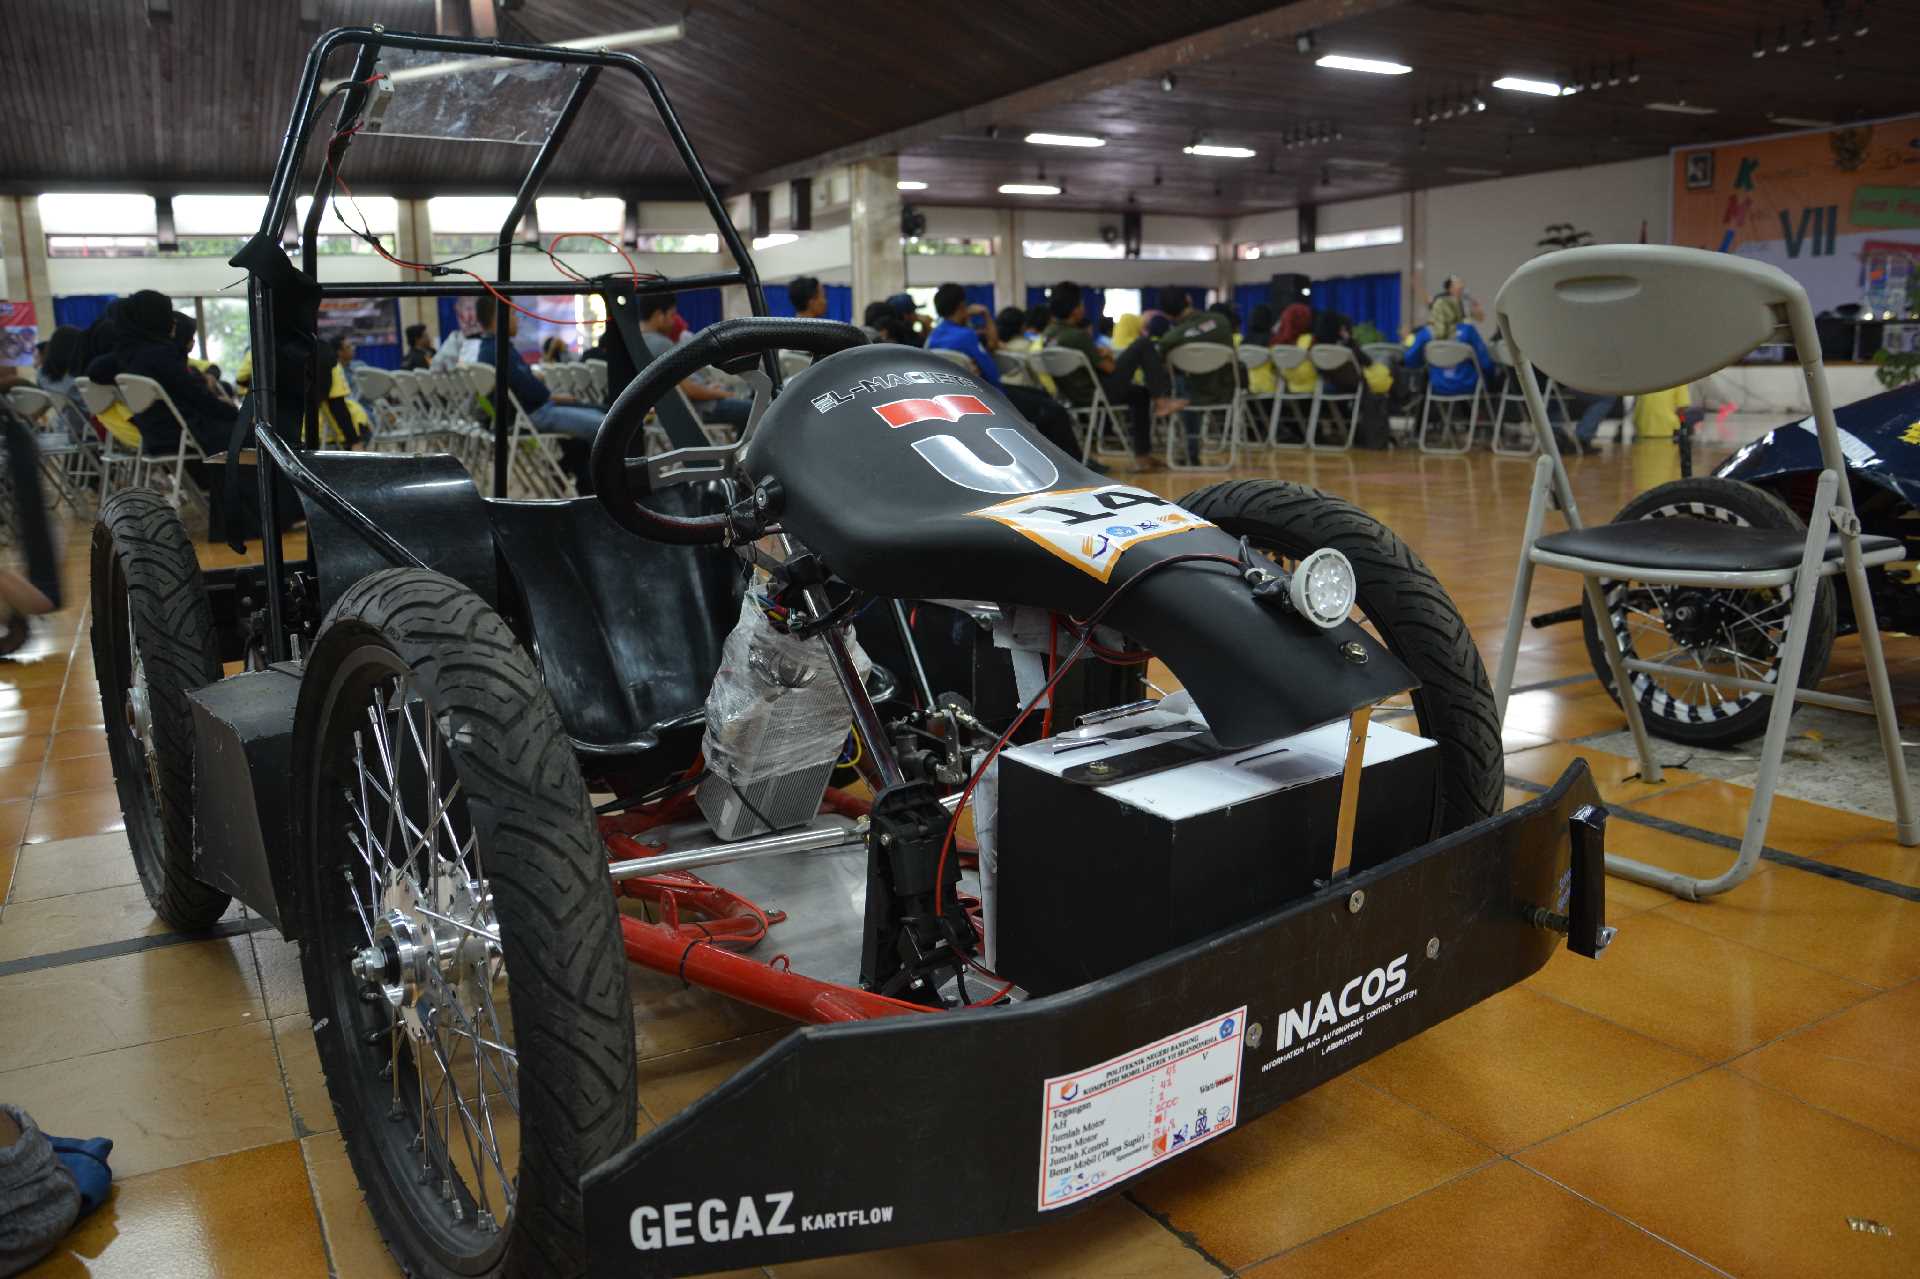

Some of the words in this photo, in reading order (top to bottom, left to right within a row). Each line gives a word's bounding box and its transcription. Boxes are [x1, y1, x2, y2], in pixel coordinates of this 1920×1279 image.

[1779, 205, 1838, 259] VII
[1019, 491, 1170, 526] 14
[1276, 953, 1408, 1051] INACOS
[1261, 1046, 1304, 1073] INFORMATION
[1306, 1038, 1321, 1051] AND
[1366, 1002, 1393, 1021] CONTROL
[1394, 989, 1418, 1006] SYSTEM
[1321, 1028, 1363, 1056] LABORATORY
[1105, 1058, 1145, 1079] POLITEKNIK
[1147, 1048, 1170, 1065] NEGERI
[1170, 1035, 1199, 1052] BANDUNG
[1083, 1076, 1120, 1096] KOMPETISI
[1121, 1067, 1141, 1081] MOBIL
[1142, 1058, 1166, 1073] LISTRIK
[1053, 1101, 1092, 1119] Tegangan
[1053, 1119, 1067, 1130] AH
[1050, 1127, 1081, 1143] Jumlah
[1082, 1118, 1106, 1132] Motor
[1050, 1142, 1073, 1155] Daya
[1074, 1133, 1099, 1147] Motor
[1049, 1151, 1079, 1167] Jumlah
[1081, 1137, 1110, 1157] Kontrol
[1049, 1166, 1072, 1178] Berat
[1073, 1154, 1097, 1169] Mobil
[629, 1190, 796, 1251] GEGAZ
[801, 1206, 894, 1232] KARTFLOW
